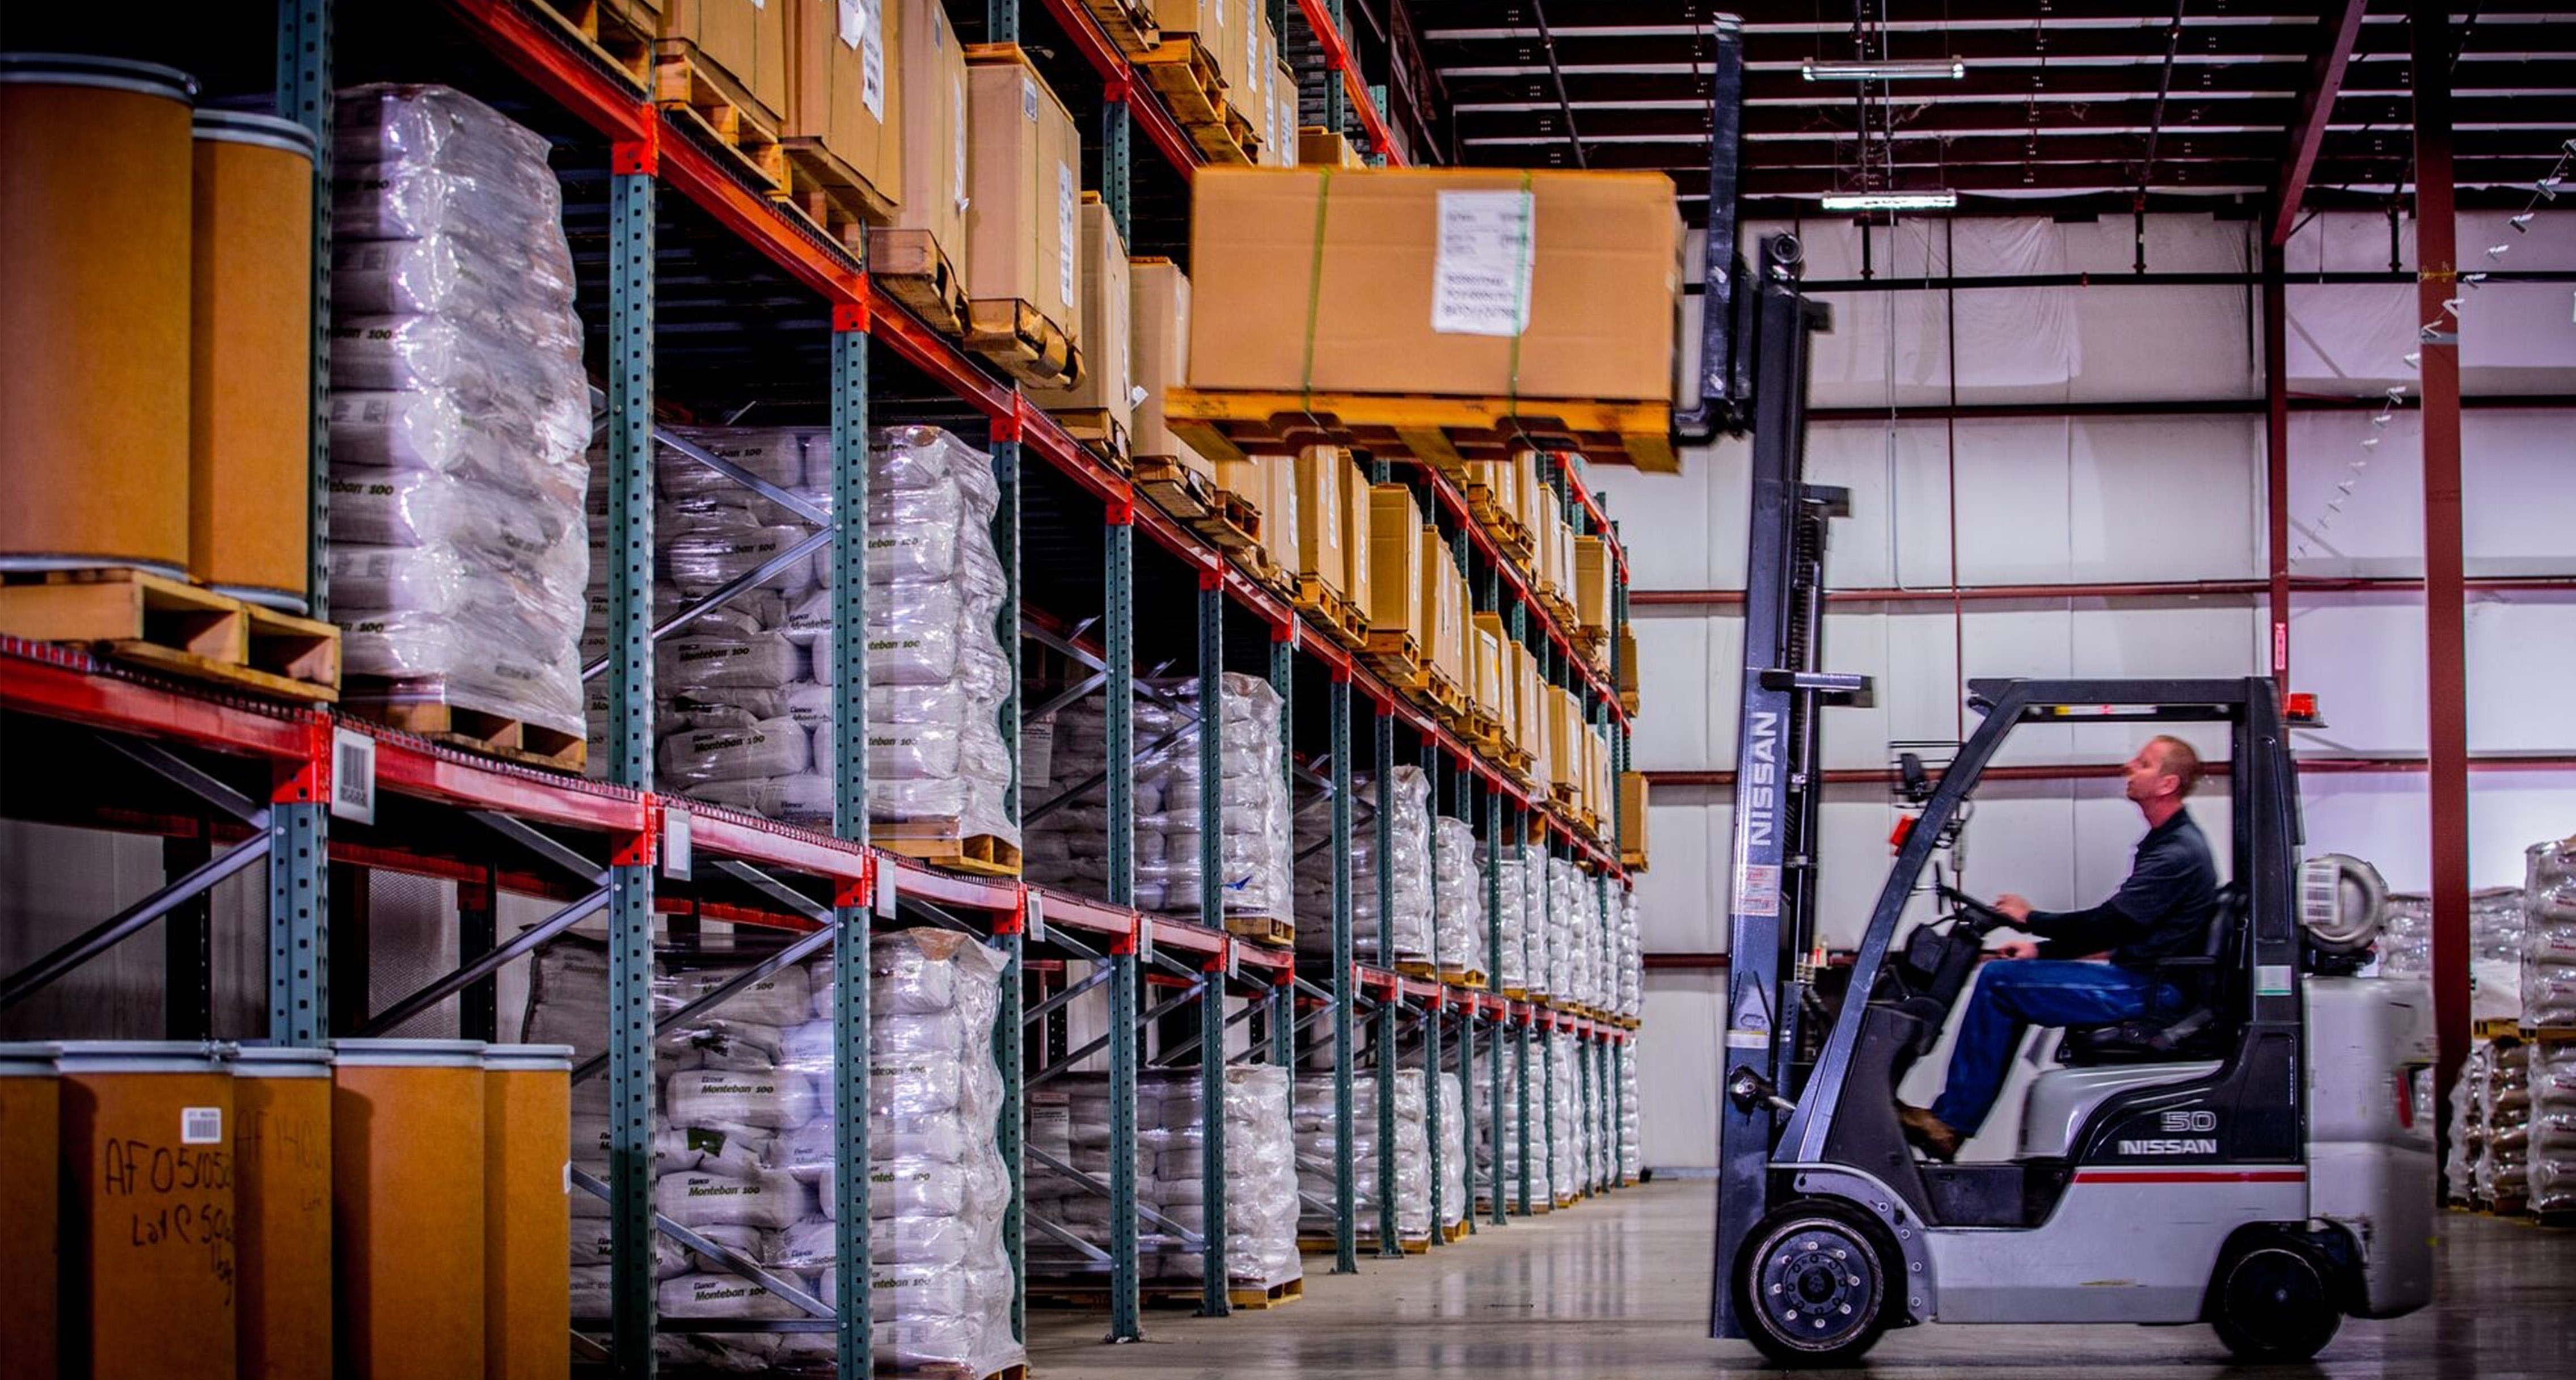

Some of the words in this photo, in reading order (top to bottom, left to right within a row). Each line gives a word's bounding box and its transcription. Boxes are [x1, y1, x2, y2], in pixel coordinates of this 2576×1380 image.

[366, 330, 392, 339] 100
[369, 484, 394, 496] 100
[868, 538, 897, 548] teban
[694, 737, 743, 753] Monteban
[868, 736, 896, 746] teban
[1750, 711, 1777, 846] NISSAN
[700, 1084, 751, 1094] Monteban
[2160, 1111, 2217, 1132] 50
[2118, 1138, 2217, 1155] NISSAN
[687, 1186, 738, 1197] Monteban
[872, 1278, 909, 1289] nteban
[695, 1288, 745, 1302] Monteban
